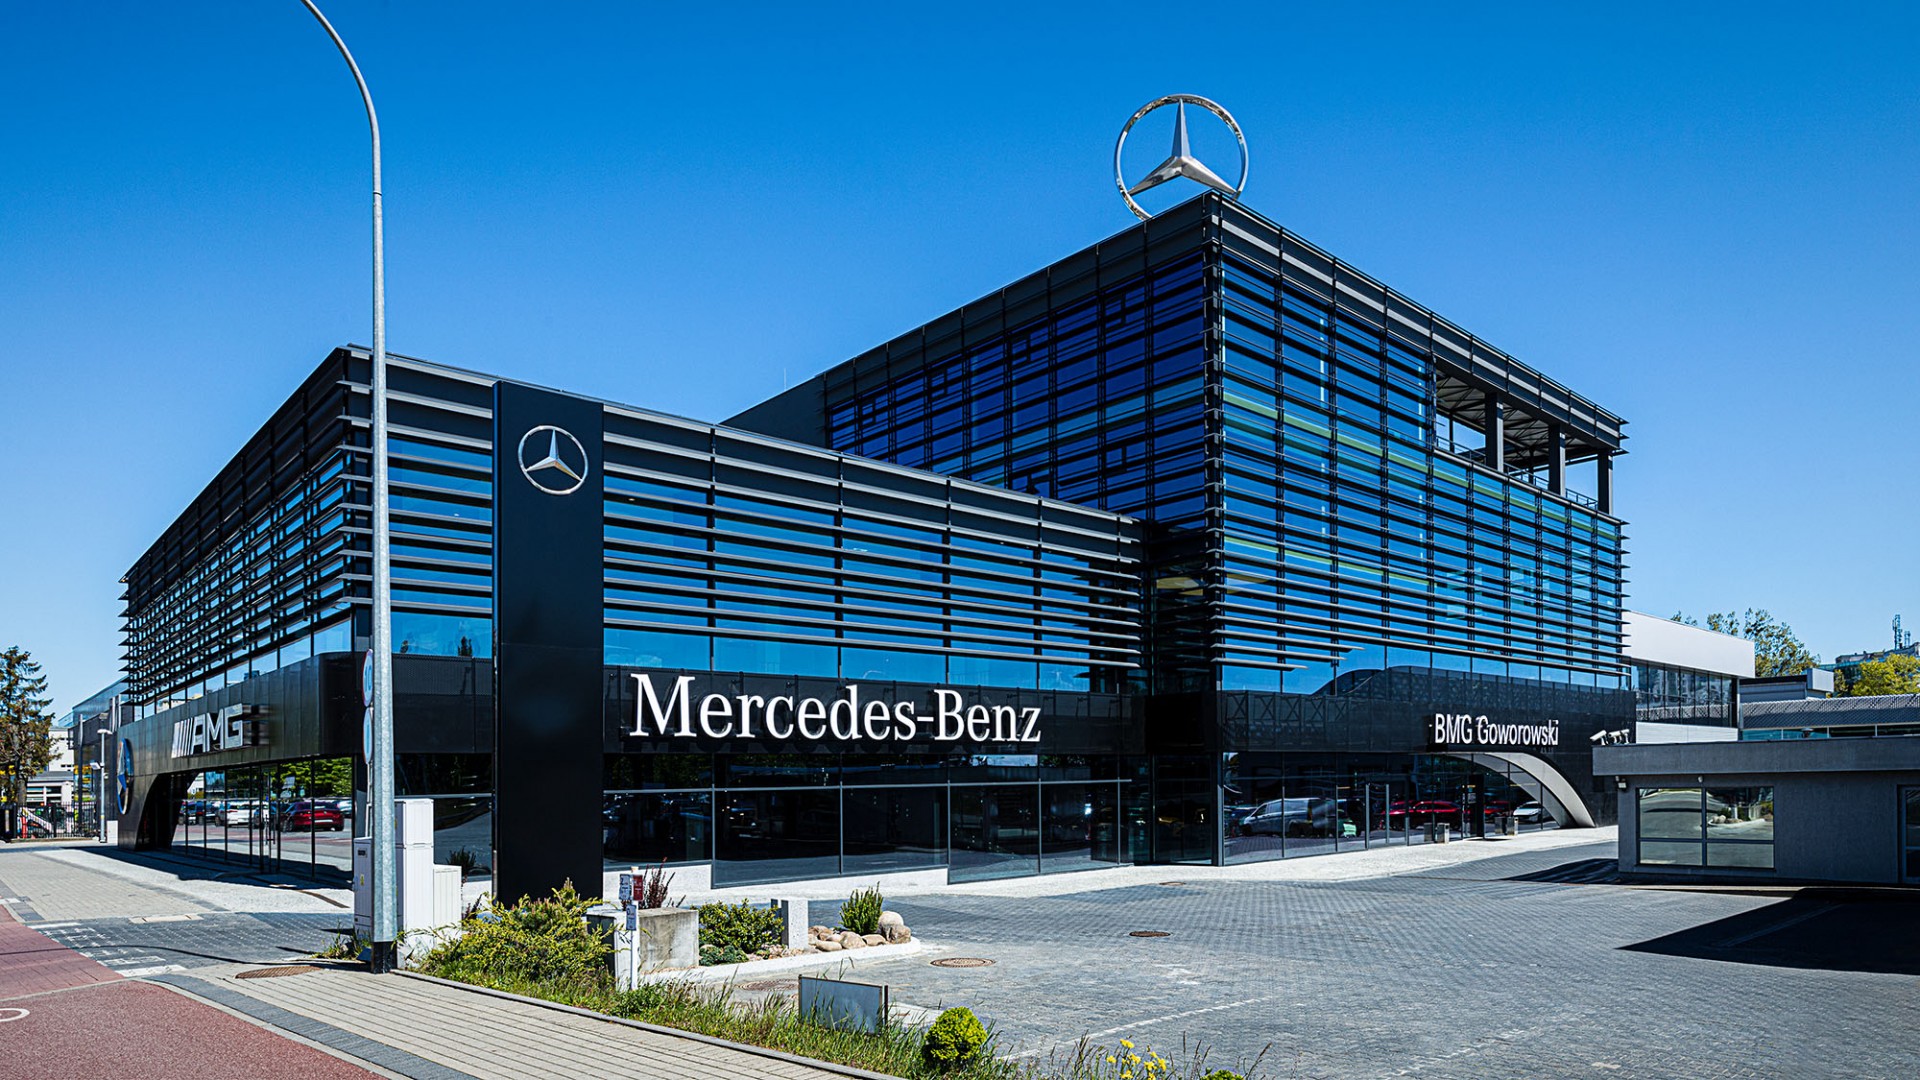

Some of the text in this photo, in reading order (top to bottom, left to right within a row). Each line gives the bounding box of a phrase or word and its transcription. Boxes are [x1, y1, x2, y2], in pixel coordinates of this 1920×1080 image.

[190, 703, 243, 755] AMG
[629, 673, 1042, 742] Mercedes-Benz
[1434, 713, 1559, 746] BMG Goworowski
